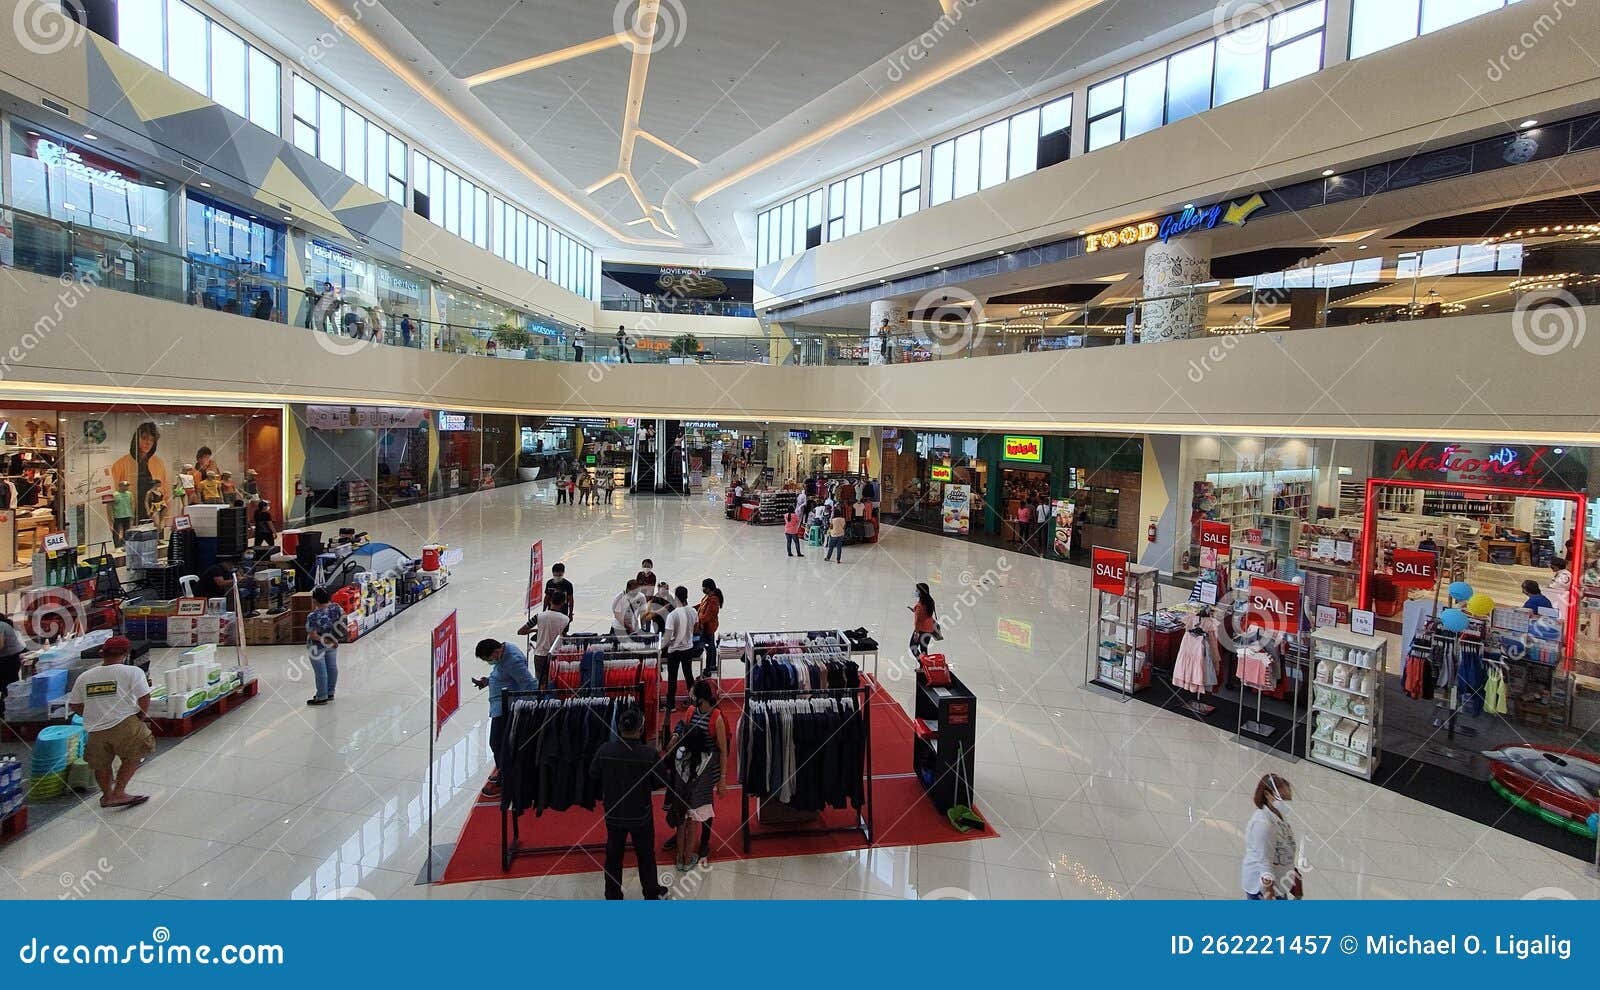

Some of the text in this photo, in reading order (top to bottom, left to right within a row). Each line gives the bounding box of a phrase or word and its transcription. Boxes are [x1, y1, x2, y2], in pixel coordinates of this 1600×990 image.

[1085, 204, 1223, 253] FOOD Gallery
[47, 536, 64, 546] SALE
[1203, 533, 1228, 545] SALE
[1096, 563, 1123, 580] SALE
[1395, 562, 1431, 577] SALE
[1253, 595, 1295, 616] SALE
